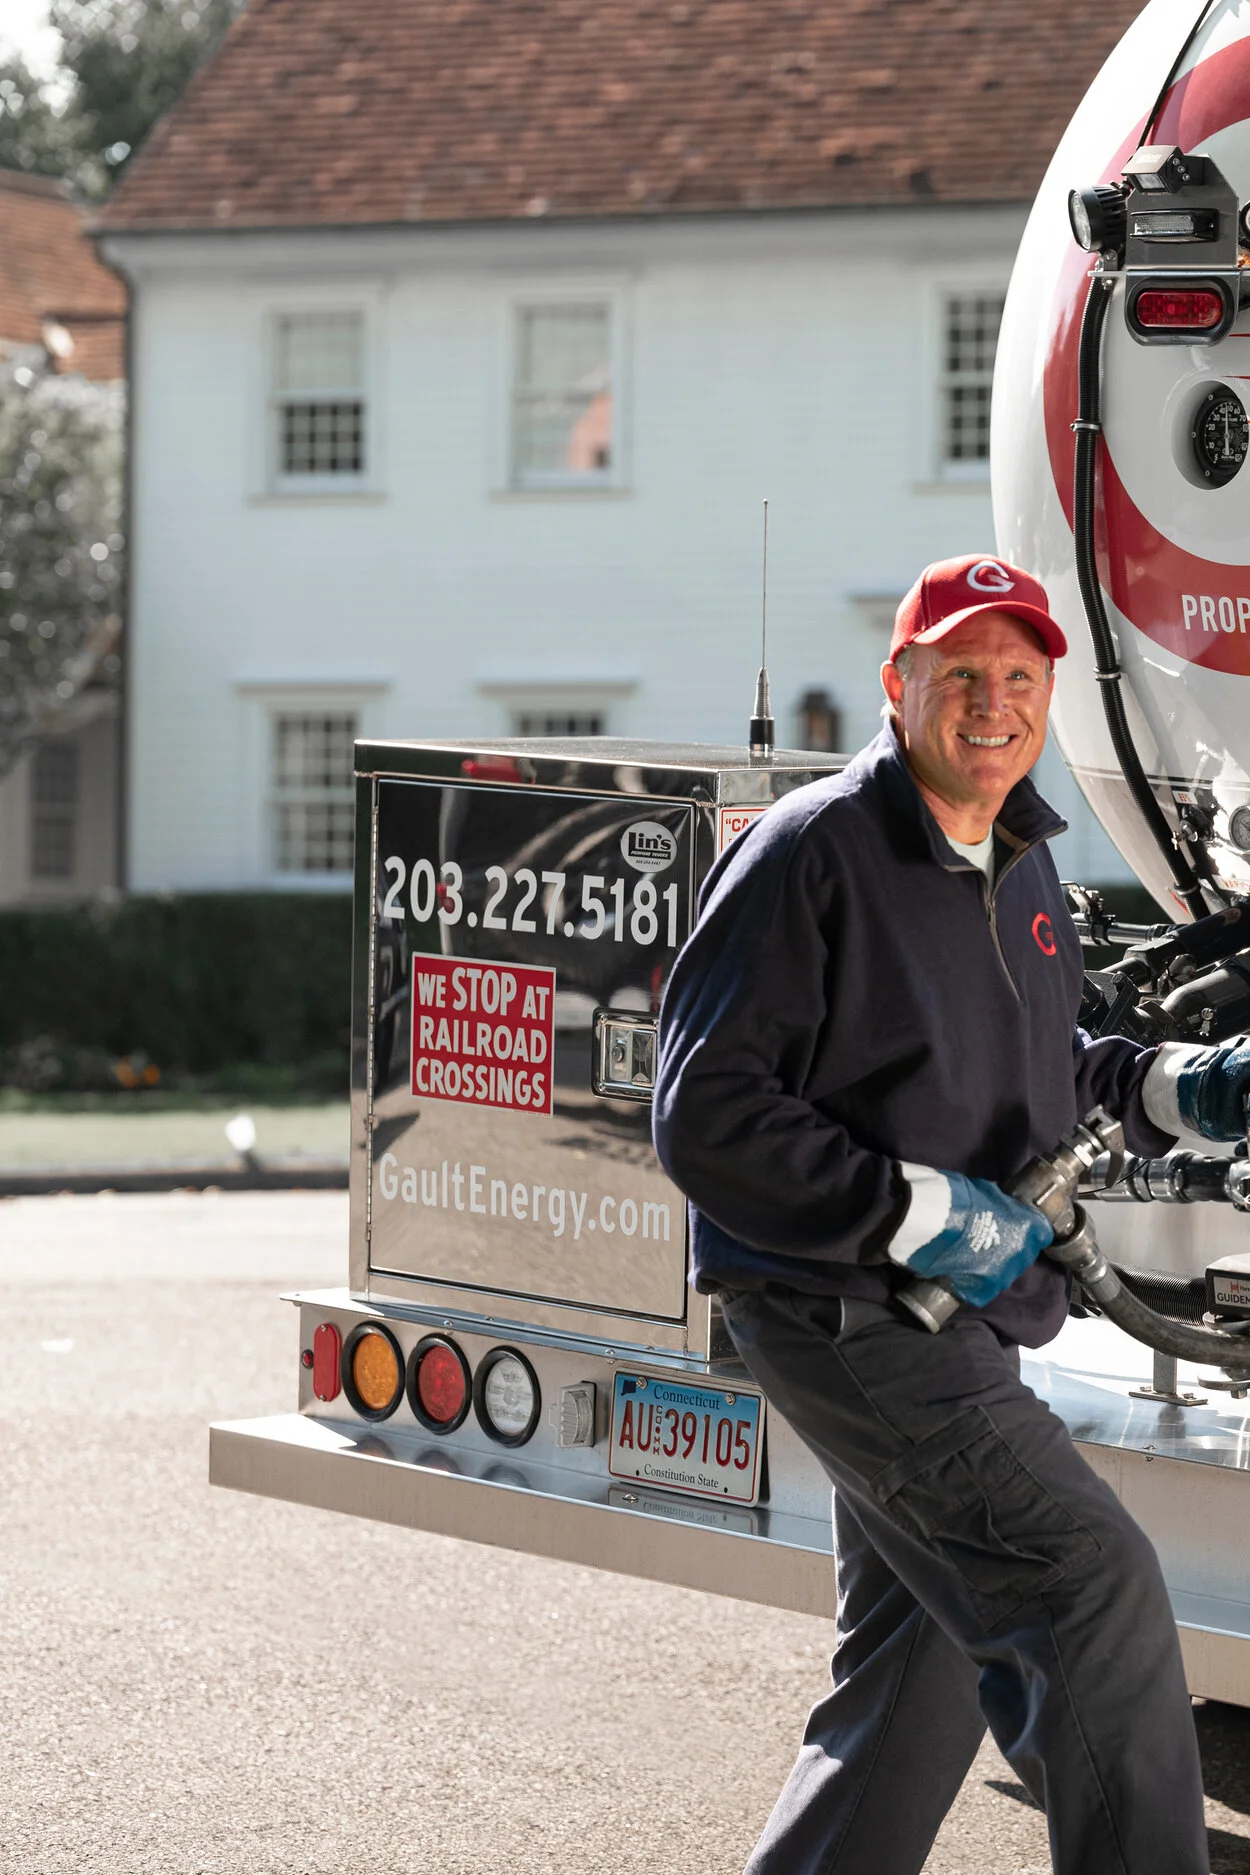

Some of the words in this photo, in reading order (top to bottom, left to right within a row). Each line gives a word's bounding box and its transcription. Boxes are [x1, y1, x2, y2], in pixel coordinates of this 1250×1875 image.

[628, 831, 672, 851] Lin's
[383, 856, 678, 948] 203.227.5181
[417, 972, 447, 1009] WE
[452, 966, 518, 1017] STOP
[521, 985, 550, 1021] AT
[419, 1014, 548, 1064] RAILROAD
[416, 1056, 546, 1108] CROSSINGS
[378, 1152, 671, 1242] GaultEnergy.com
[653, 1384, 721, 1411] Connecticut
[643, 1463, 695, 1484] Constitution
[697, 1473, 719, 1489] State
